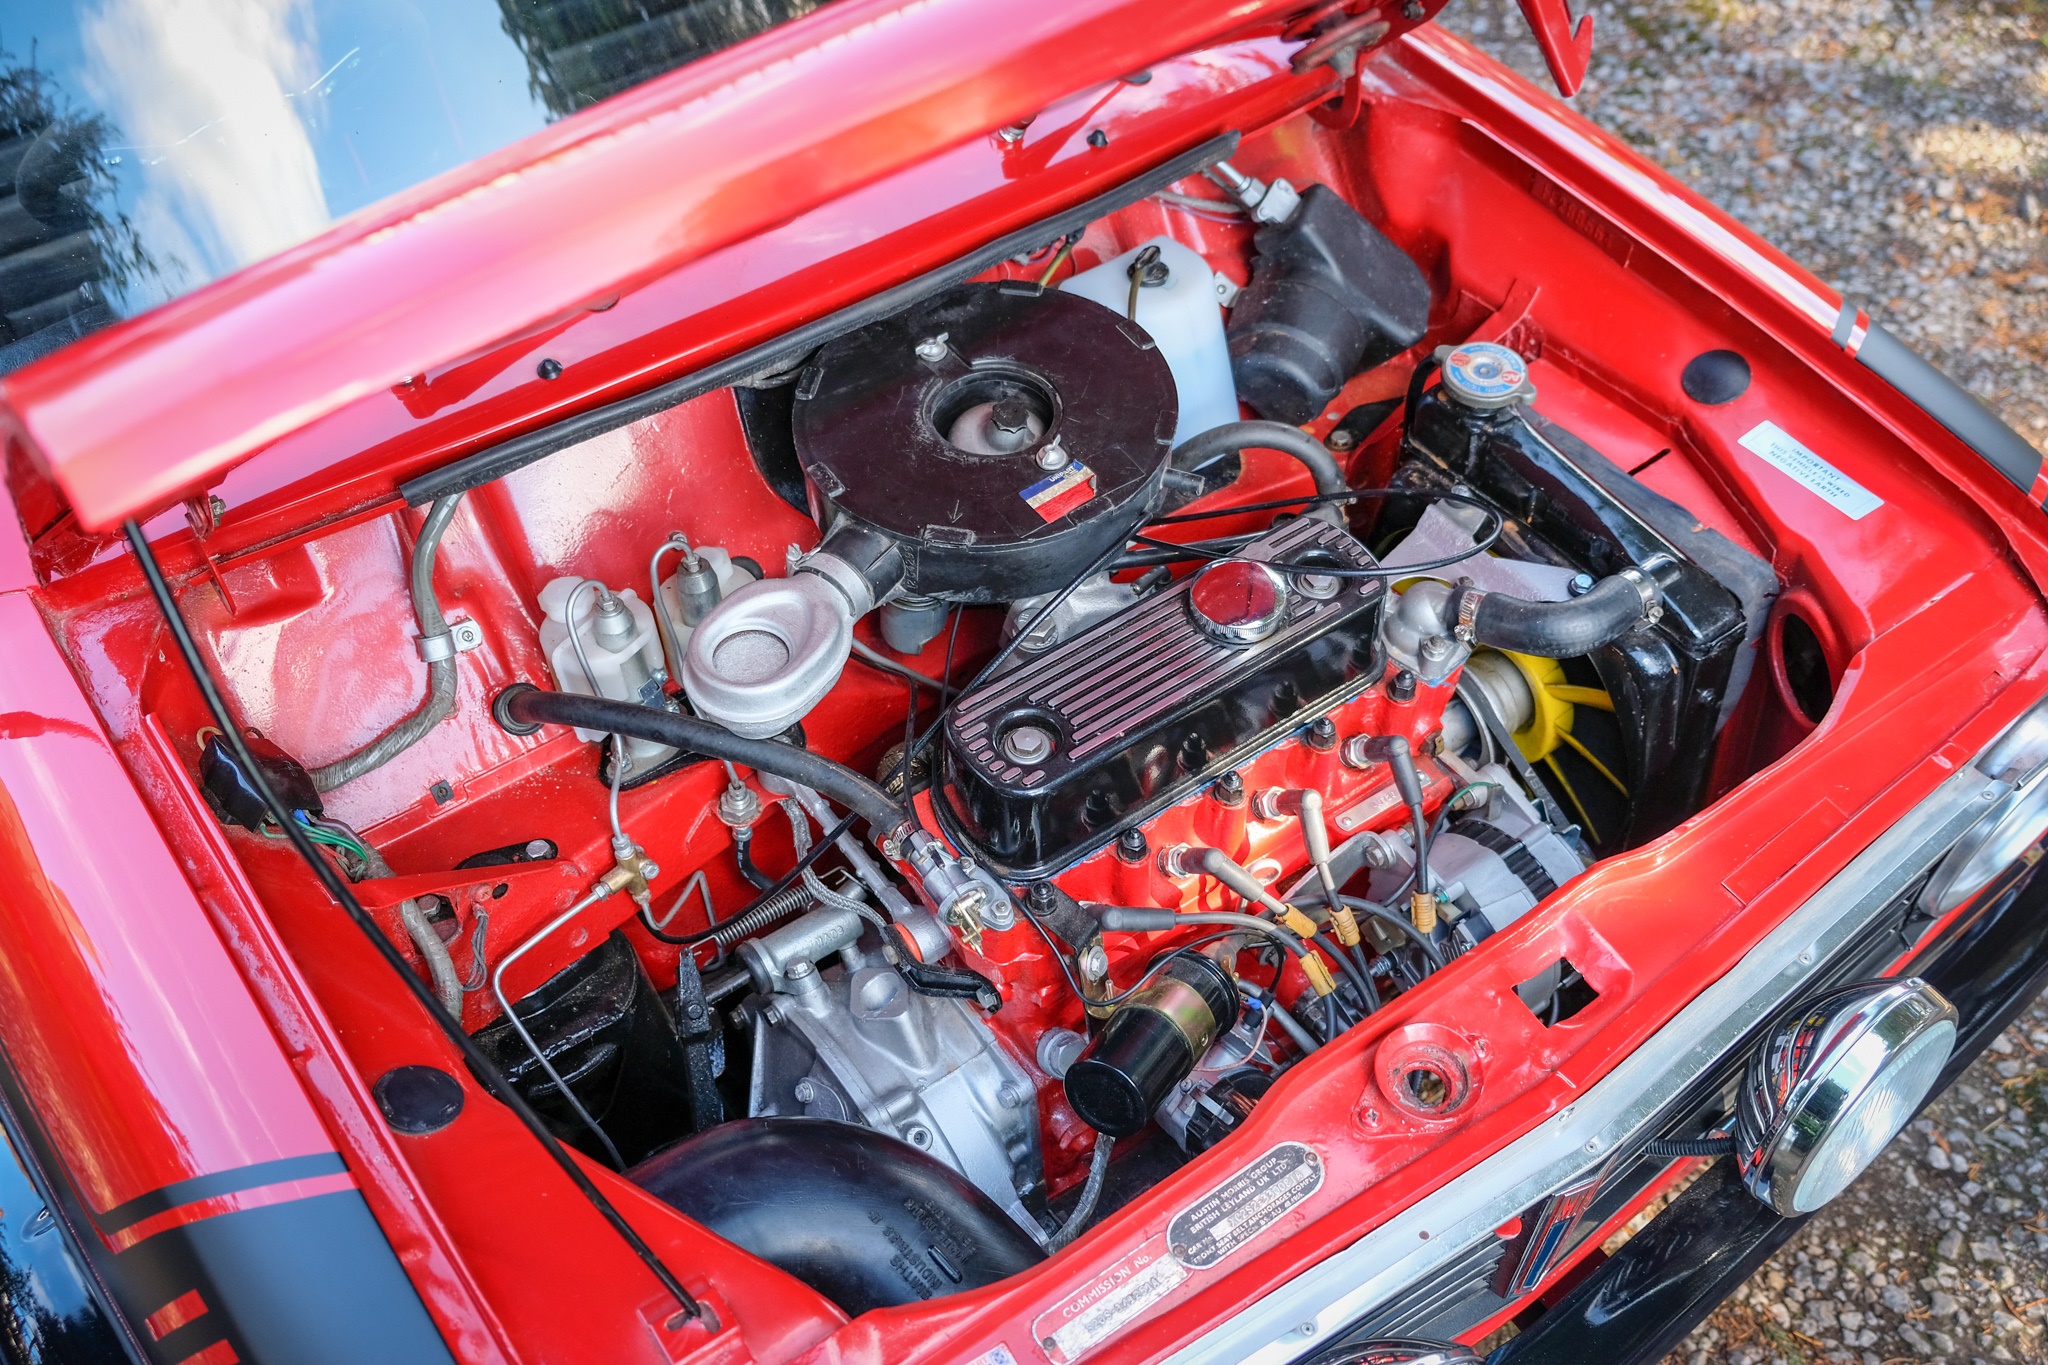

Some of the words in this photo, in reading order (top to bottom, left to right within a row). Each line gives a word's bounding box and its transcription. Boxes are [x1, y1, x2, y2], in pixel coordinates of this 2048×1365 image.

[1048, 465, 1076, 482] UNIPART
[1768, 450, 1809, 478] NEGATIVE
[1809, 478, 1838, 497] EARTH
[1770, 442, 1787, 454] THIS
[1787, 455, 1817, 475] VEHICLE
[1826, 481, 1850, 497] WIRED
[1791, 448, 1840, 482] IMPORTANT
[1190, 1198, 1219, 1220] AUSTIN
[1221, 1177, 1249, 1200] MORRIS
[1251, 1157, 1277, 1178] GROUP
[1190, 1210, 1219, 1233] BRITISH
[1221, 1185, 1256, 1212] LEYLAND
[1256, 1174, 1270, 1187] UK
[1271, 1161, 1288, 1176] LTD
[936, 1230, 968, 1264] MADE
[1186, 1241, 1202, 1255] CAR
[1192, 1245, 1216, 1264] FRONT
[1215, 1233, 1233, 1248] SEAT
[1232, 1221, 1249, 1237] BELT
[1248, 1191, 1290, 1224] ANCHORAGES
[1216, 1238, 1237, 1255] WITH
[882, 1226, 942, 1290] INDUSTRIES
[890, 1255, 932, 1301] SMITHS
[1062, 1266, 1131, 1318] COMMISSION
[1132, 1251, 1152, 1269] No.
